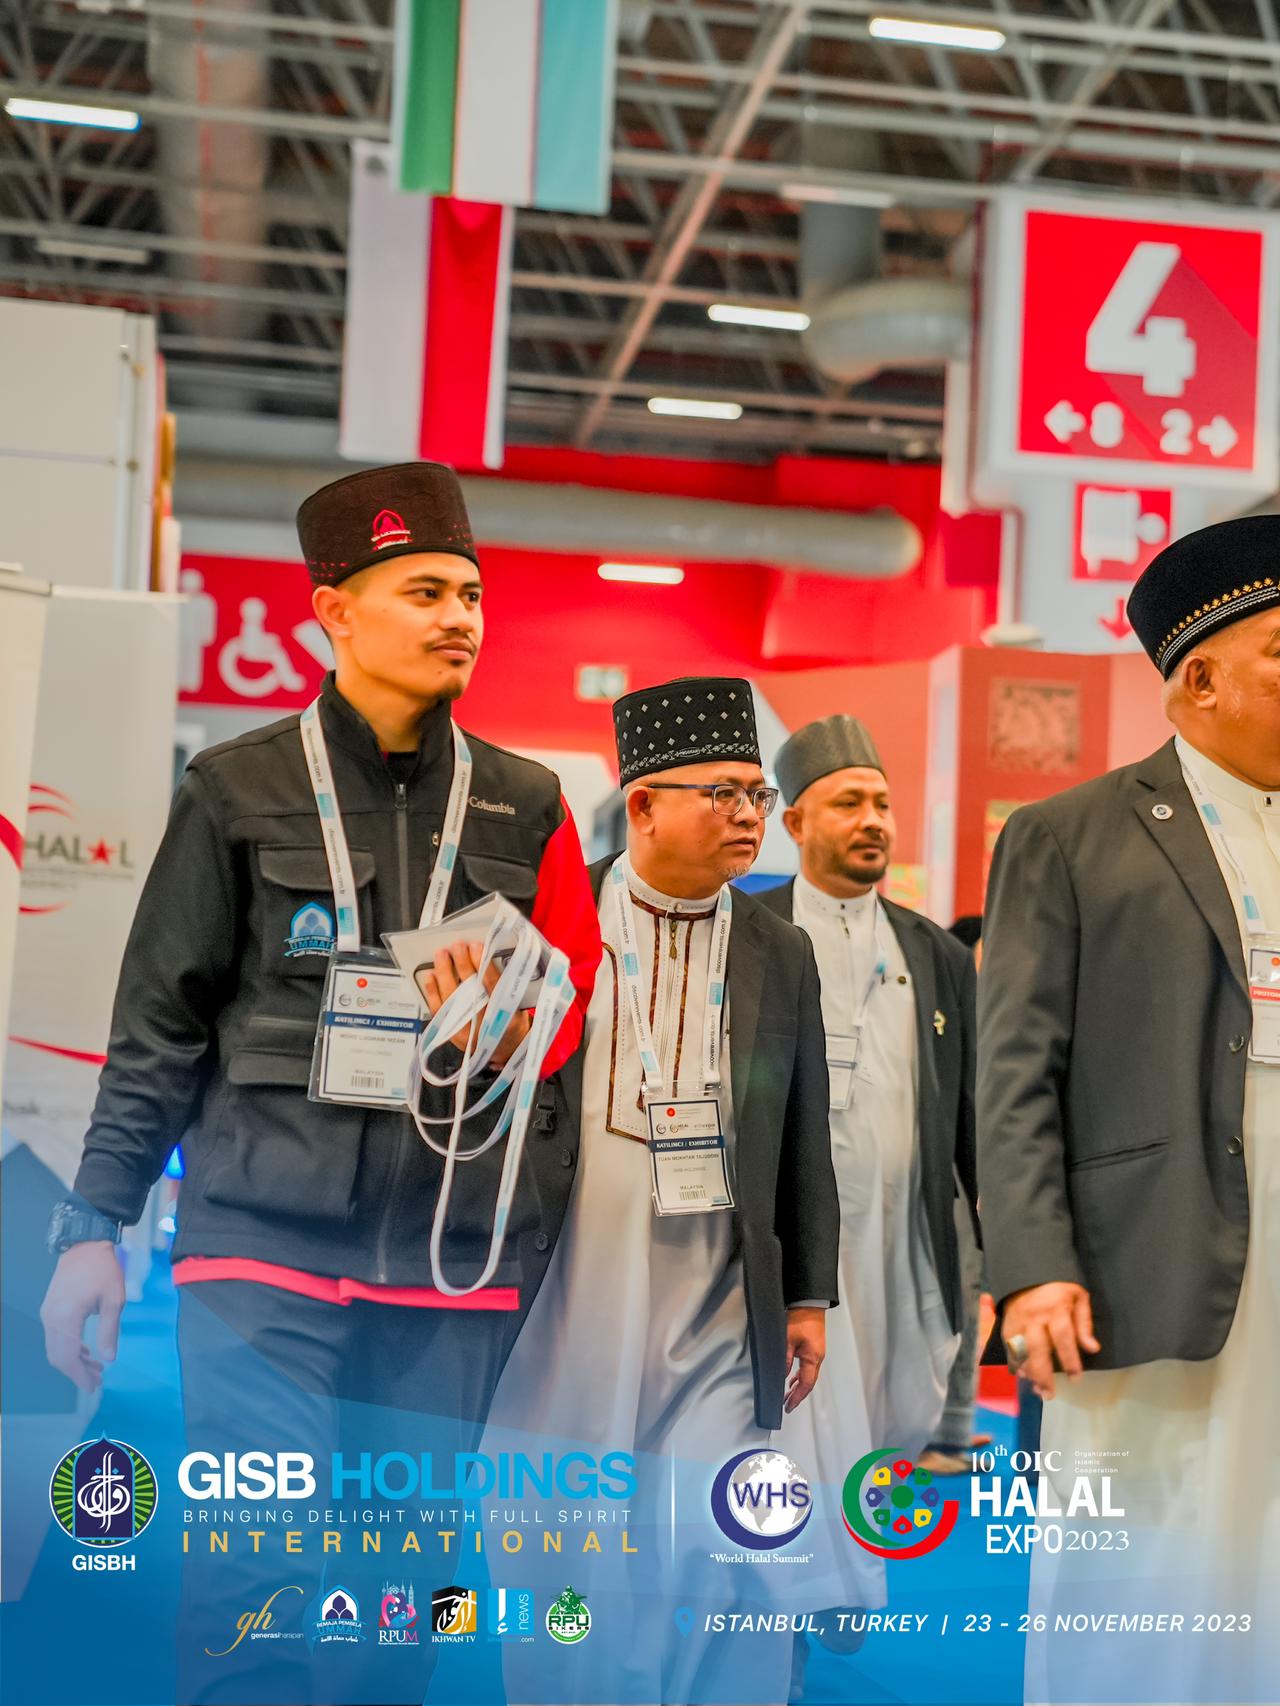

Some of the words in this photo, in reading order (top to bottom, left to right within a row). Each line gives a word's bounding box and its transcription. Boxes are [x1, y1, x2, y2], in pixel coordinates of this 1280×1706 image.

[1085, 240, 1197, 398] 4
[1160, 408, 1193, 456] 2
[469, 795, 515, 816] Columbia
